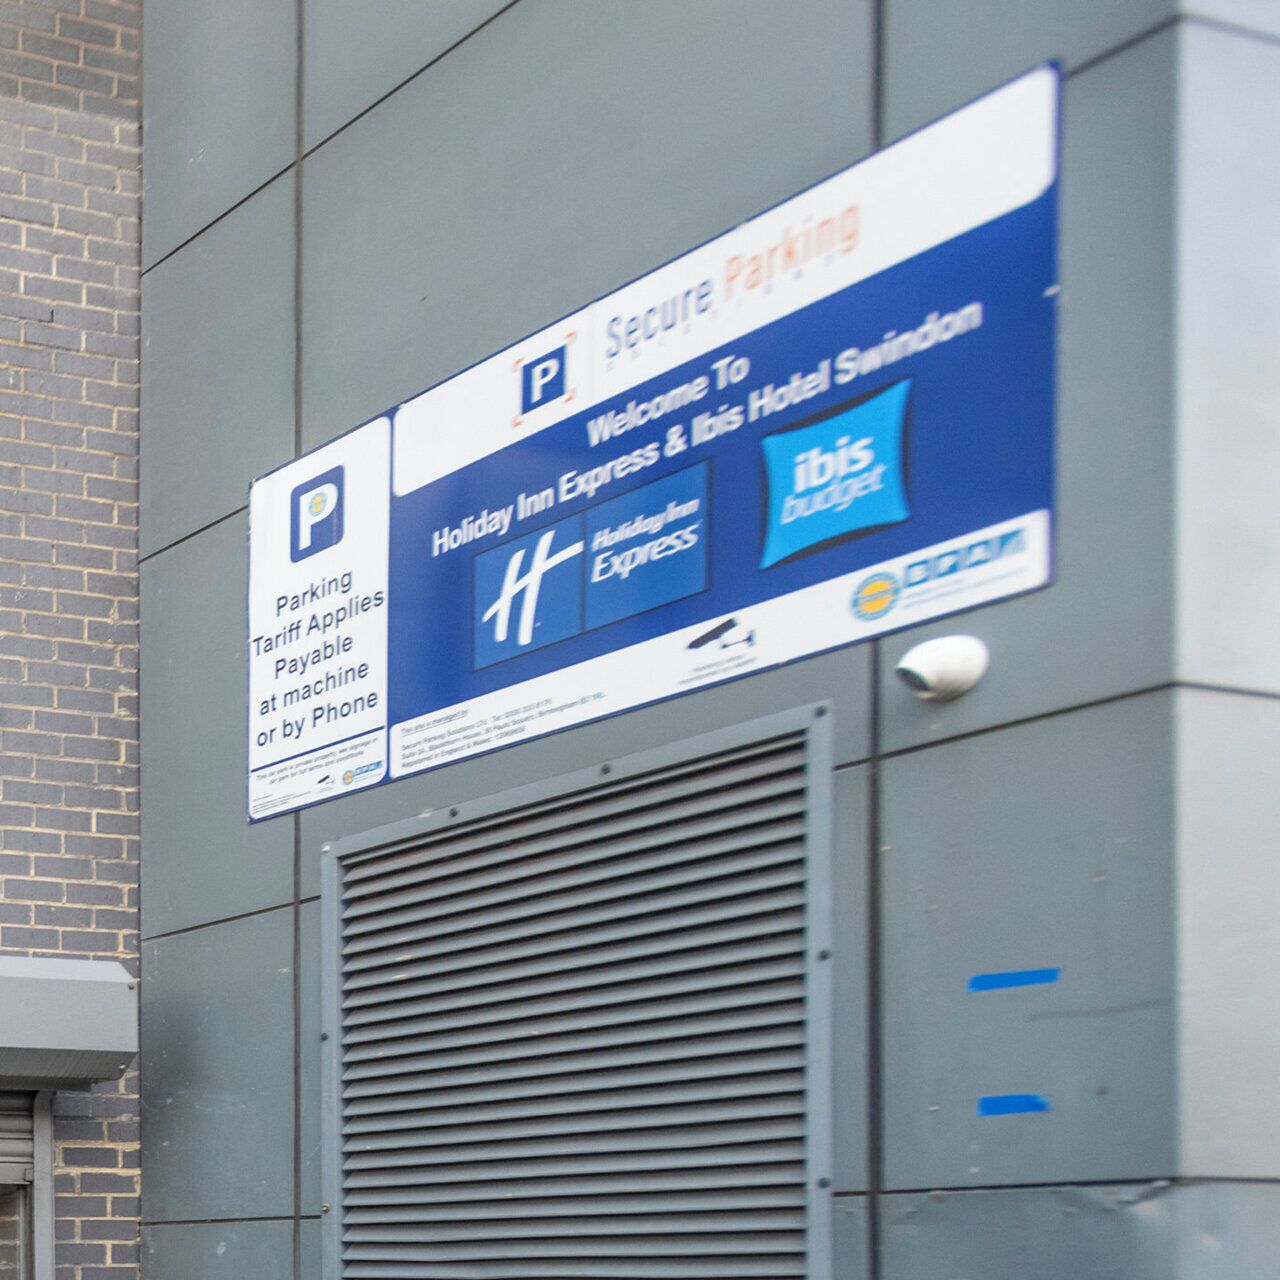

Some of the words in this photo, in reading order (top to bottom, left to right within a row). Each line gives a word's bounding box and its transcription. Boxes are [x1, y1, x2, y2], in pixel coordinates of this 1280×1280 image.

[604, 278, 715, 360] Secure
[722, 203, 861, 301] Parking
[432, 504, 514, 558] Holiday
[517, 487, 555, 522] Inn
[558, 442, 661, 503] Express
[663, 424, 689, 458] &
[691, 404, 745, 448] Ibis
[748, 358, 832, 423] Hotel
[834, 301, 984, 385] Swindon
[587, 375, 710, 448] Welcome
[710, 355, 751, 390] To
[780, 463, 888, 525] budget
[794, 435, 876, 494] ibis
[591, 514, 665, 552] Holiday
[665, 499, 701, 524] Inn
[591, 519, 703, 583] Express
[253, 619, 302, 656] Tariff
[306, 591, 385, 636] Applies
[276, 570, 352, 617] Parking
[275, 635, 353, 680] Payable
[259, 693, 277, 716] at
[283, 662, 369, 707] machine
[256, 727, 277, 747] or
[282, 717, 306, 740] by
[312, 692, 379, 728] Phone
